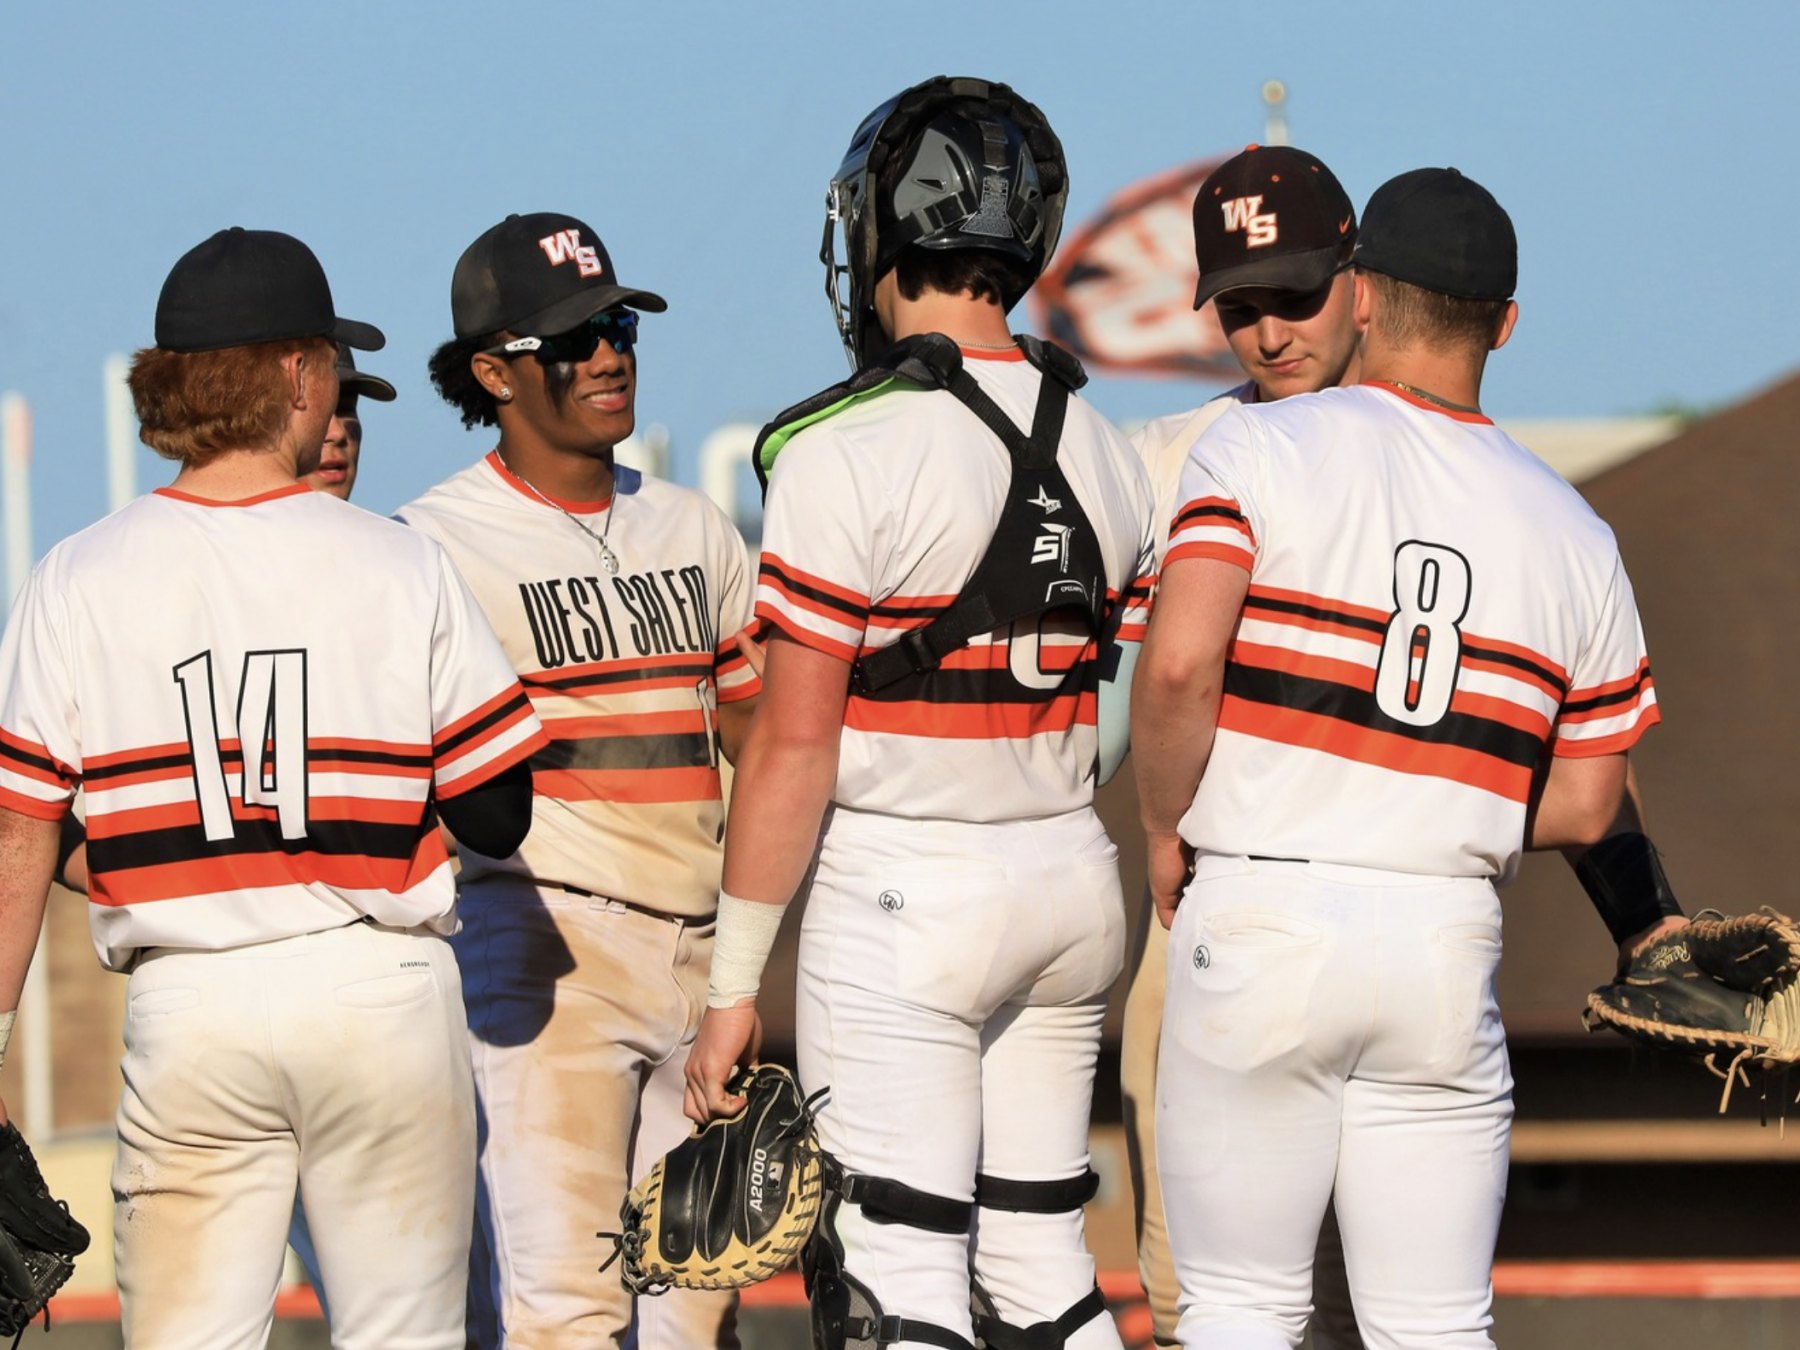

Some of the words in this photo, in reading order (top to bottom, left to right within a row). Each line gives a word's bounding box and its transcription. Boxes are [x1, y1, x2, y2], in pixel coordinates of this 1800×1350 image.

[538, 228, 602, 278] WS
[1221, 194, 1278, 249] WS
[518, 575, 620, 669] WEST
[612, 564, 714, 658] SALEM
[1373, 539, 1473, 728] 8
[172, 648, 308, 842] 14
[749, 1148, 767, 1212] A2000
